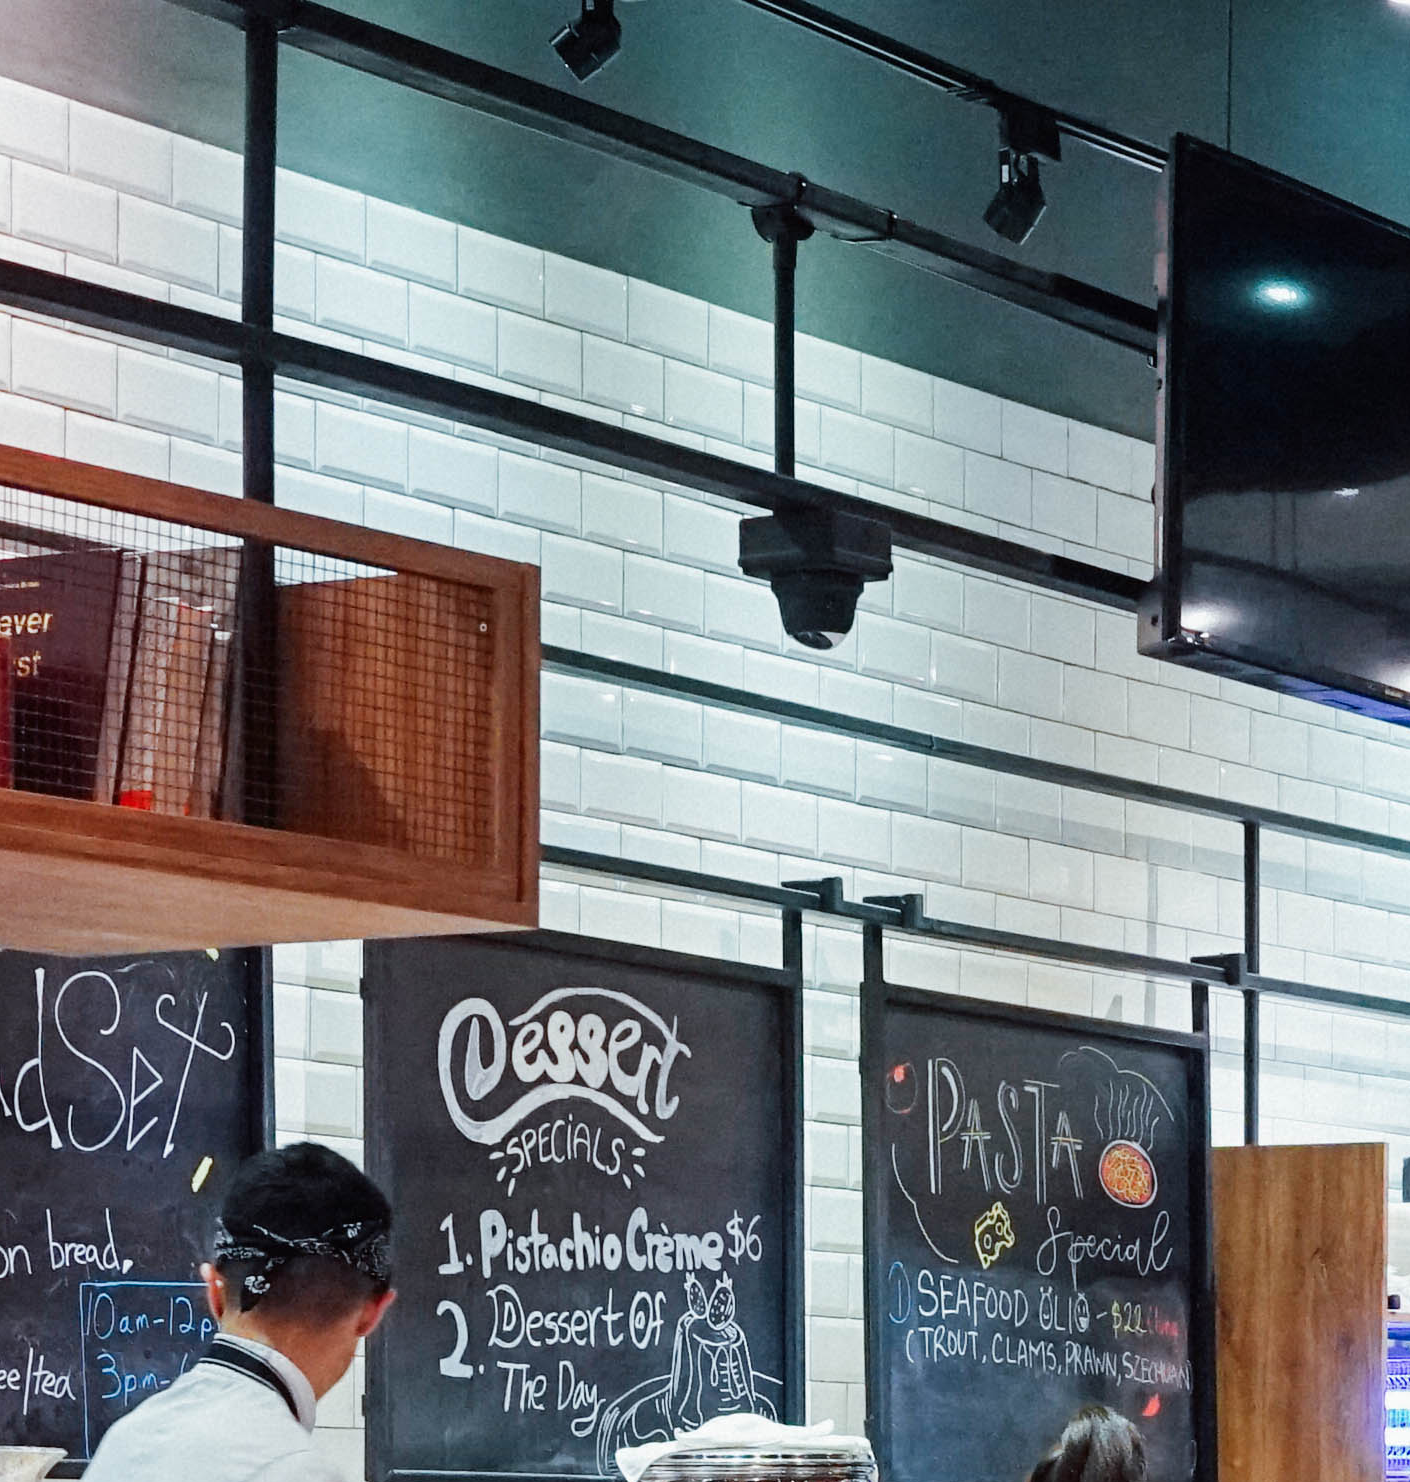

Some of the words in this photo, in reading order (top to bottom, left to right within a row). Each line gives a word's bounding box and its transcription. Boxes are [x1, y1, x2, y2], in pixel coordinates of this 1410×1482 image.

[438, 986, 691, 1145] Dessert
[927, 1057, 1084, 1204] PASTA
[438, 1212, 474, 1276] 1.
[479, 1208, 619, 1279] Pistachio
[625, 1206, 725, 1273] Crème
[727, 1208, 763, 1266] $6
[1036, 1205, 1174, 1293] Special
[86, 1290, 219, 1342] 10am-12p
[436, 1300, 486, 1378] 2.
[485, 1284, 624, 1349] Dessert
[628, 1289, 667, 1350] Of
[917, 1268, 1030, 1328] SEAFOOD
[1111, 1300, 1148, 1340] $22
[496, 1360, 548, 1412] The
[557, 1361, 608, 1438] Day
[991, 1332, 1063, 1377] CLAMS,
[1064, 1339, 1122, 1388] PRAWN,
